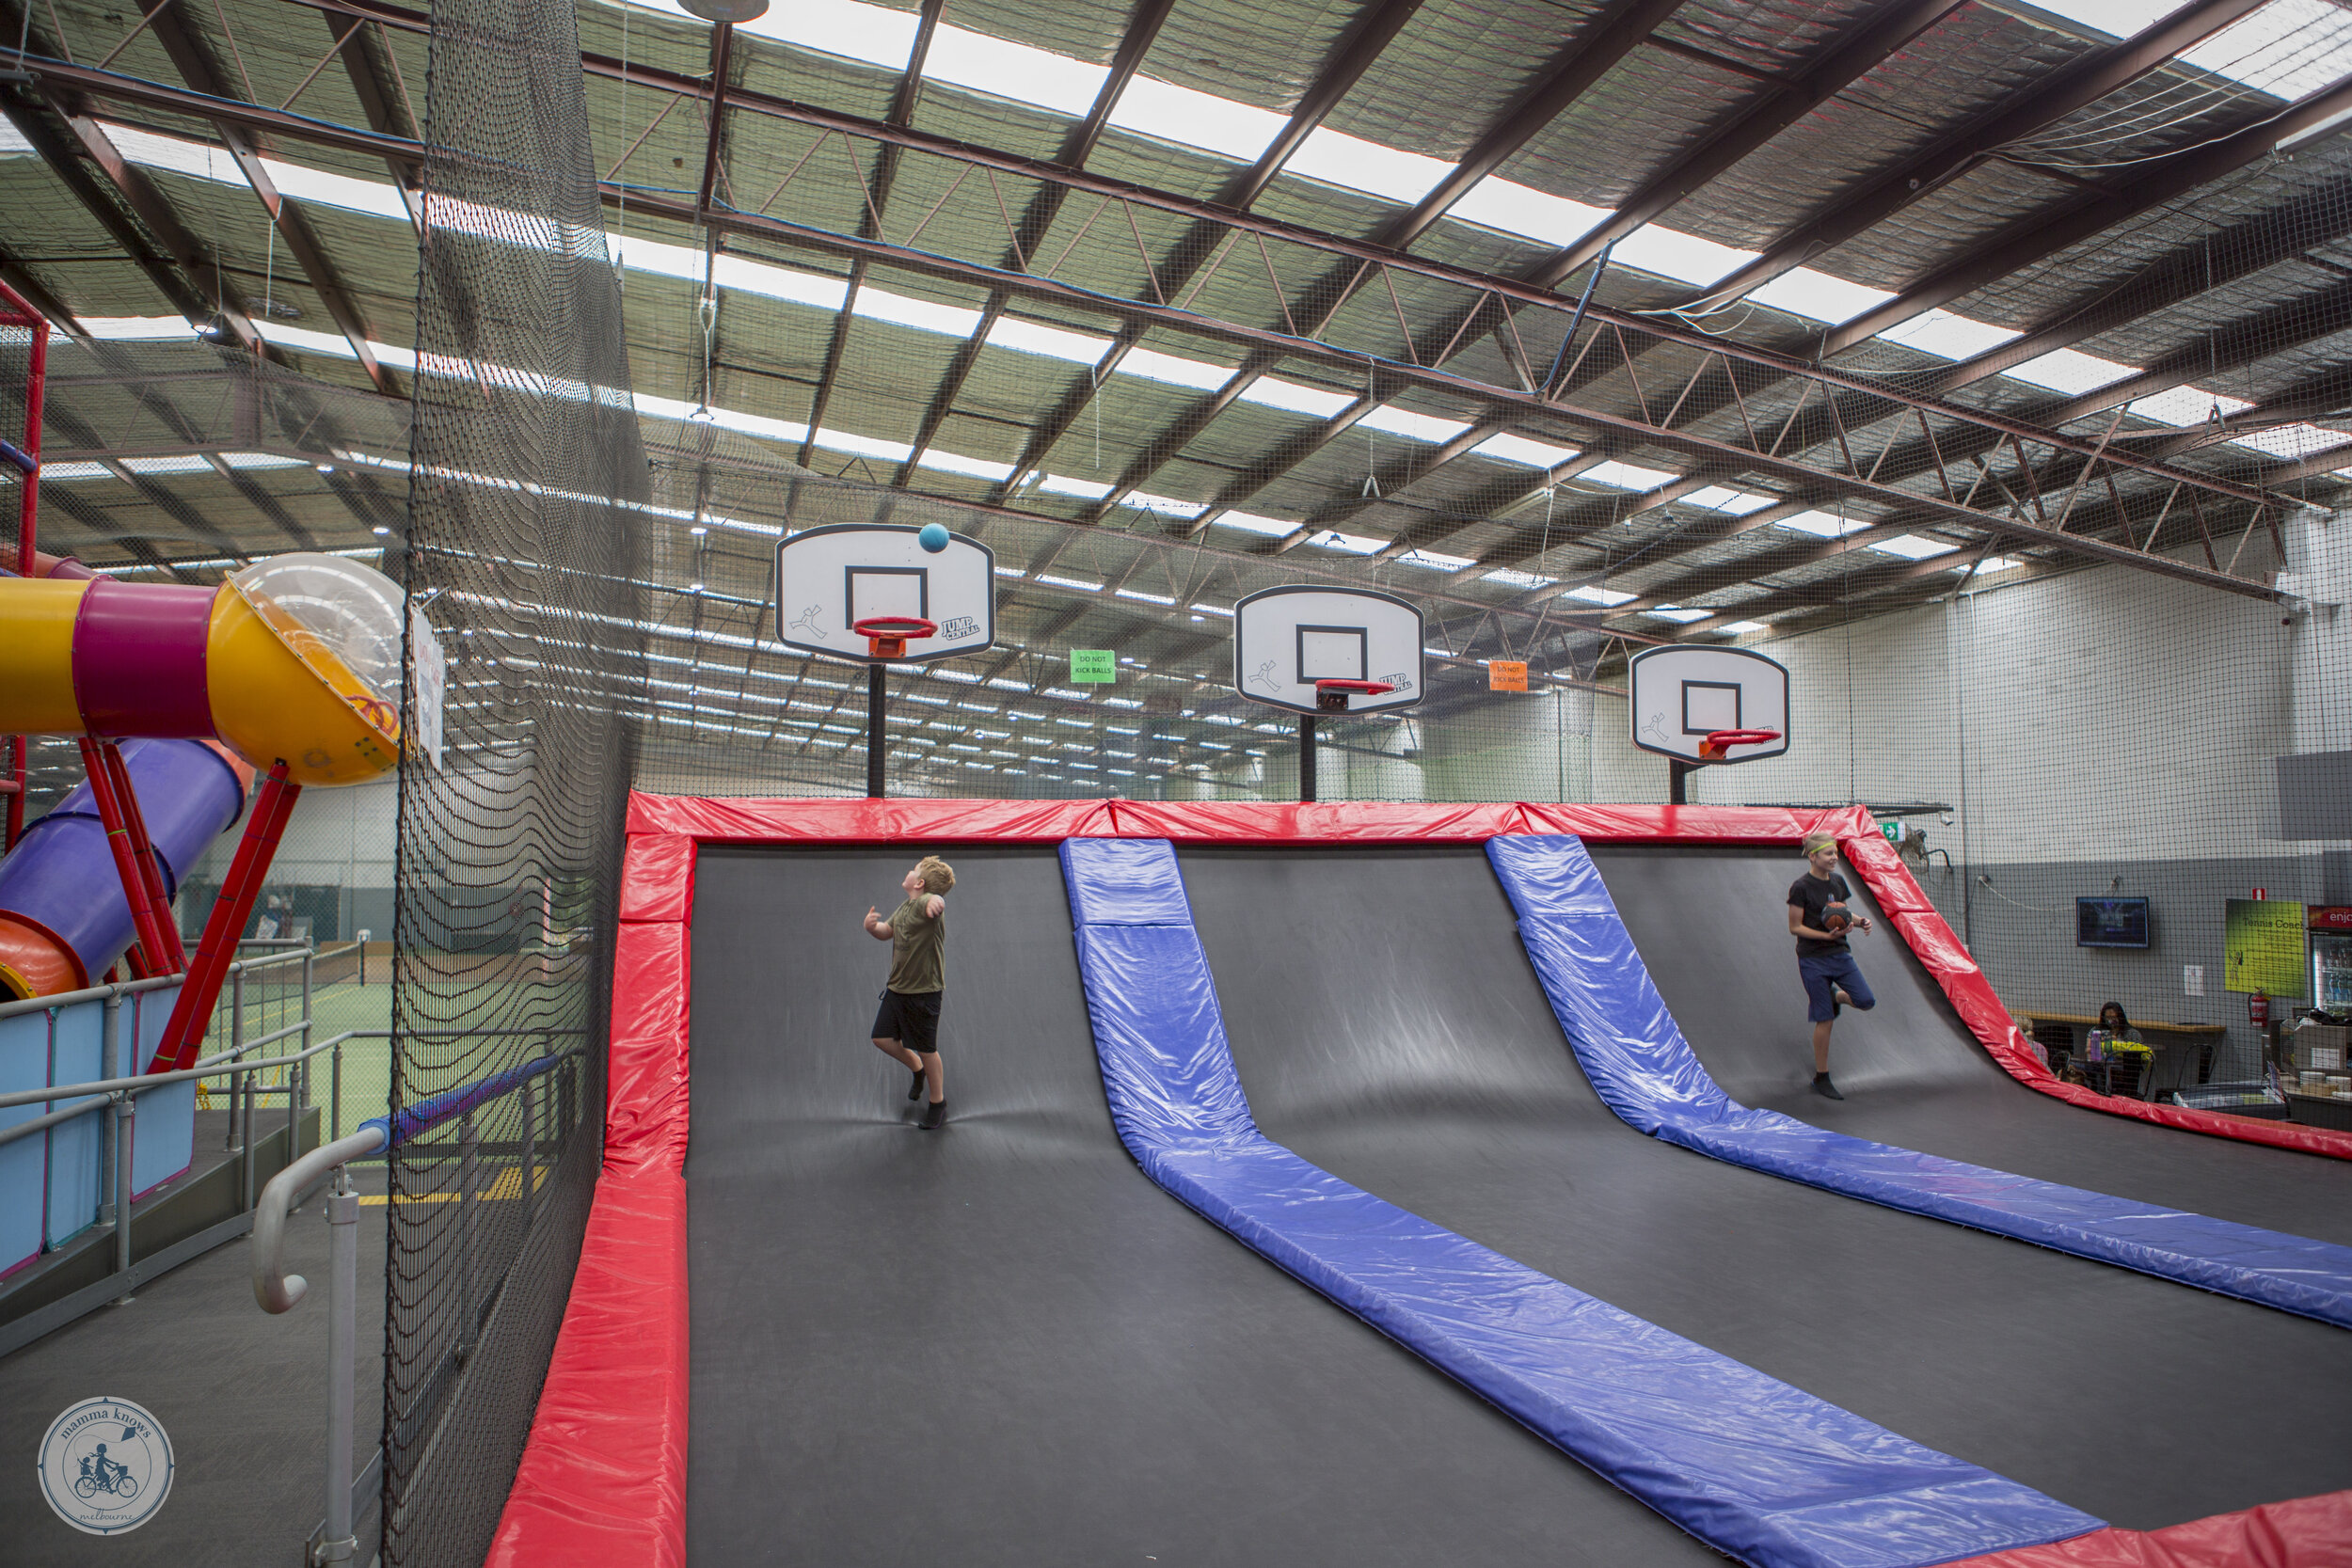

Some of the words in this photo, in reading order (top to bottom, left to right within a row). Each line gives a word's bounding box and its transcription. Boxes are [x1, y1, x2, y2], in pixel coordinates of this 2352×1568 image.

[942, 616, 973, 637] JUMP
[946, 625, 980, 641] CENTRAL
[2242, 917, 2273, 927] Tennis
